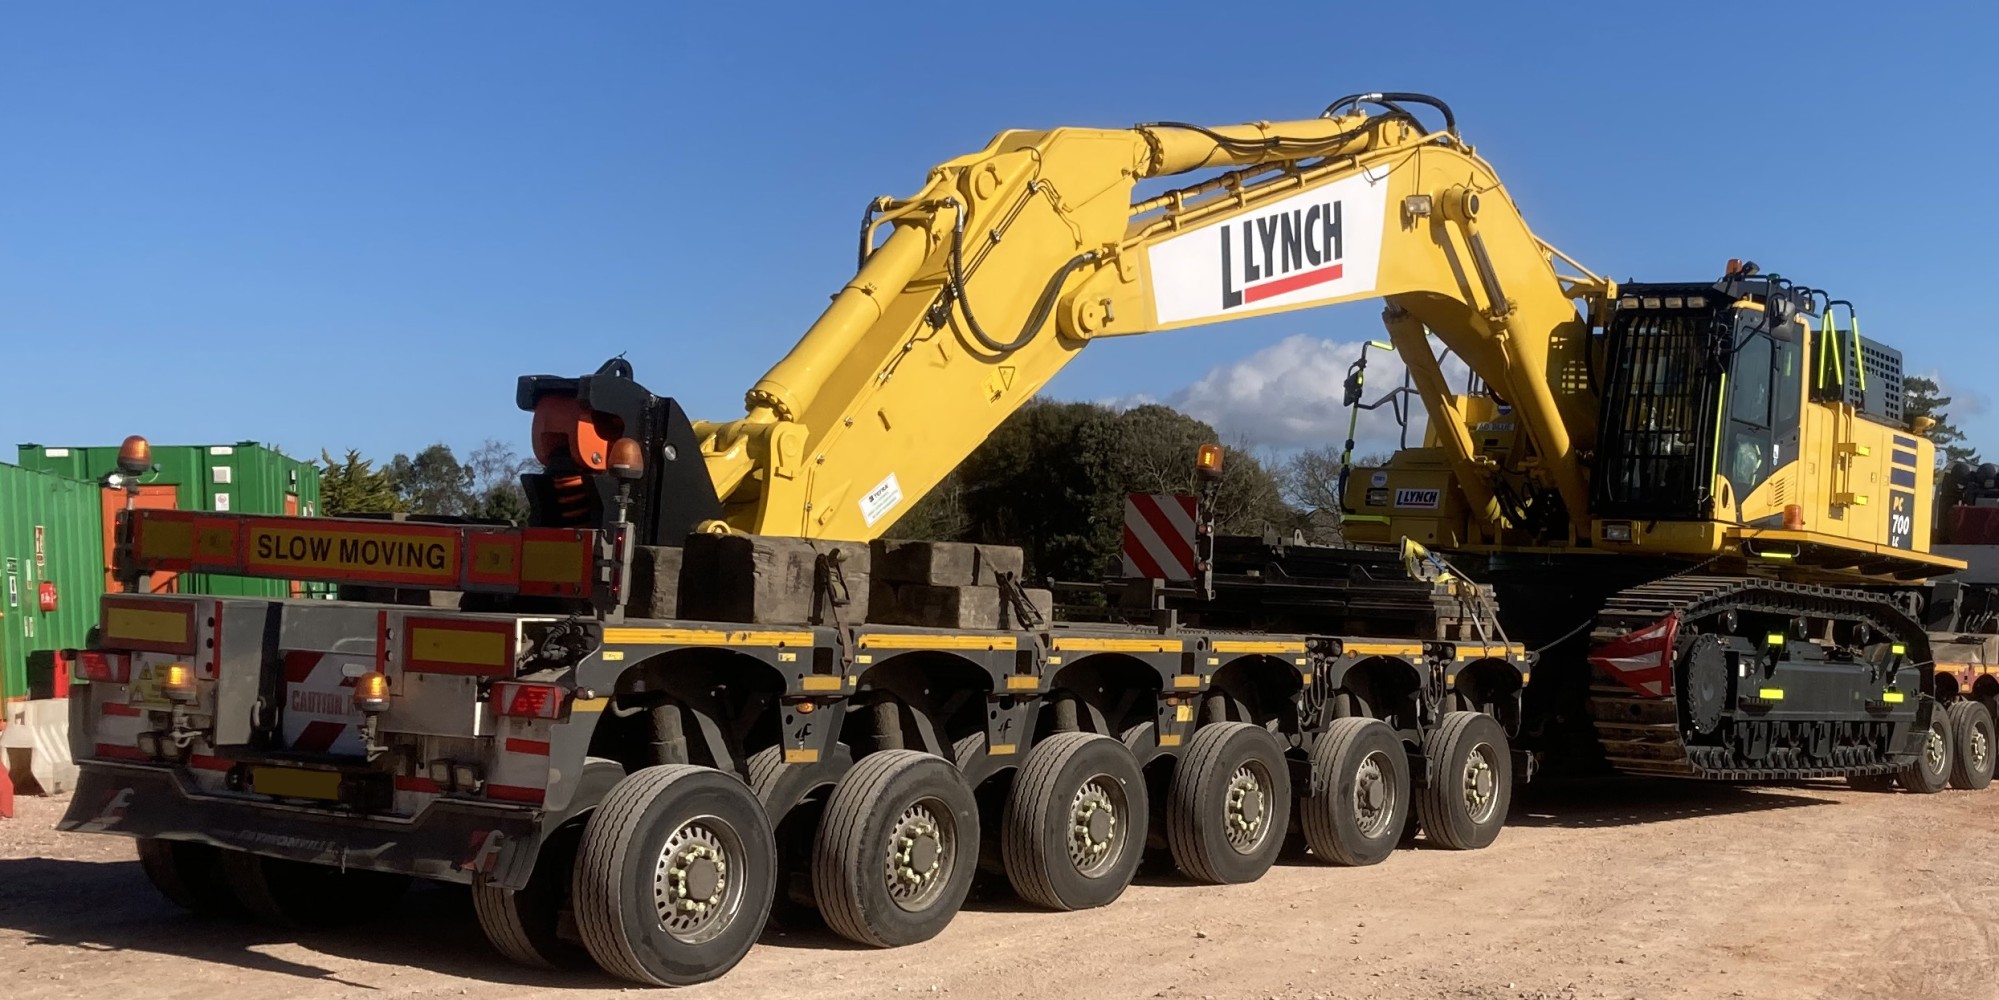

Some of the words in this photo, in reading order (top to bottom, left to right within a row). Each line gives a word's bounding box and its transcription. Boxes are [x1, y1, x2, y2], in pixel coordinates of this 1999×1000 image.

[1893, 496, 1904, 512] PC
[1892, 514, 1910, 535] 700
[1891, 535, 1900, 547] LC
[257, 534, 332, 562] SLOW
[339, 538, 446, 570] MOVING
[292, 690, 343, 715] CAUTION
